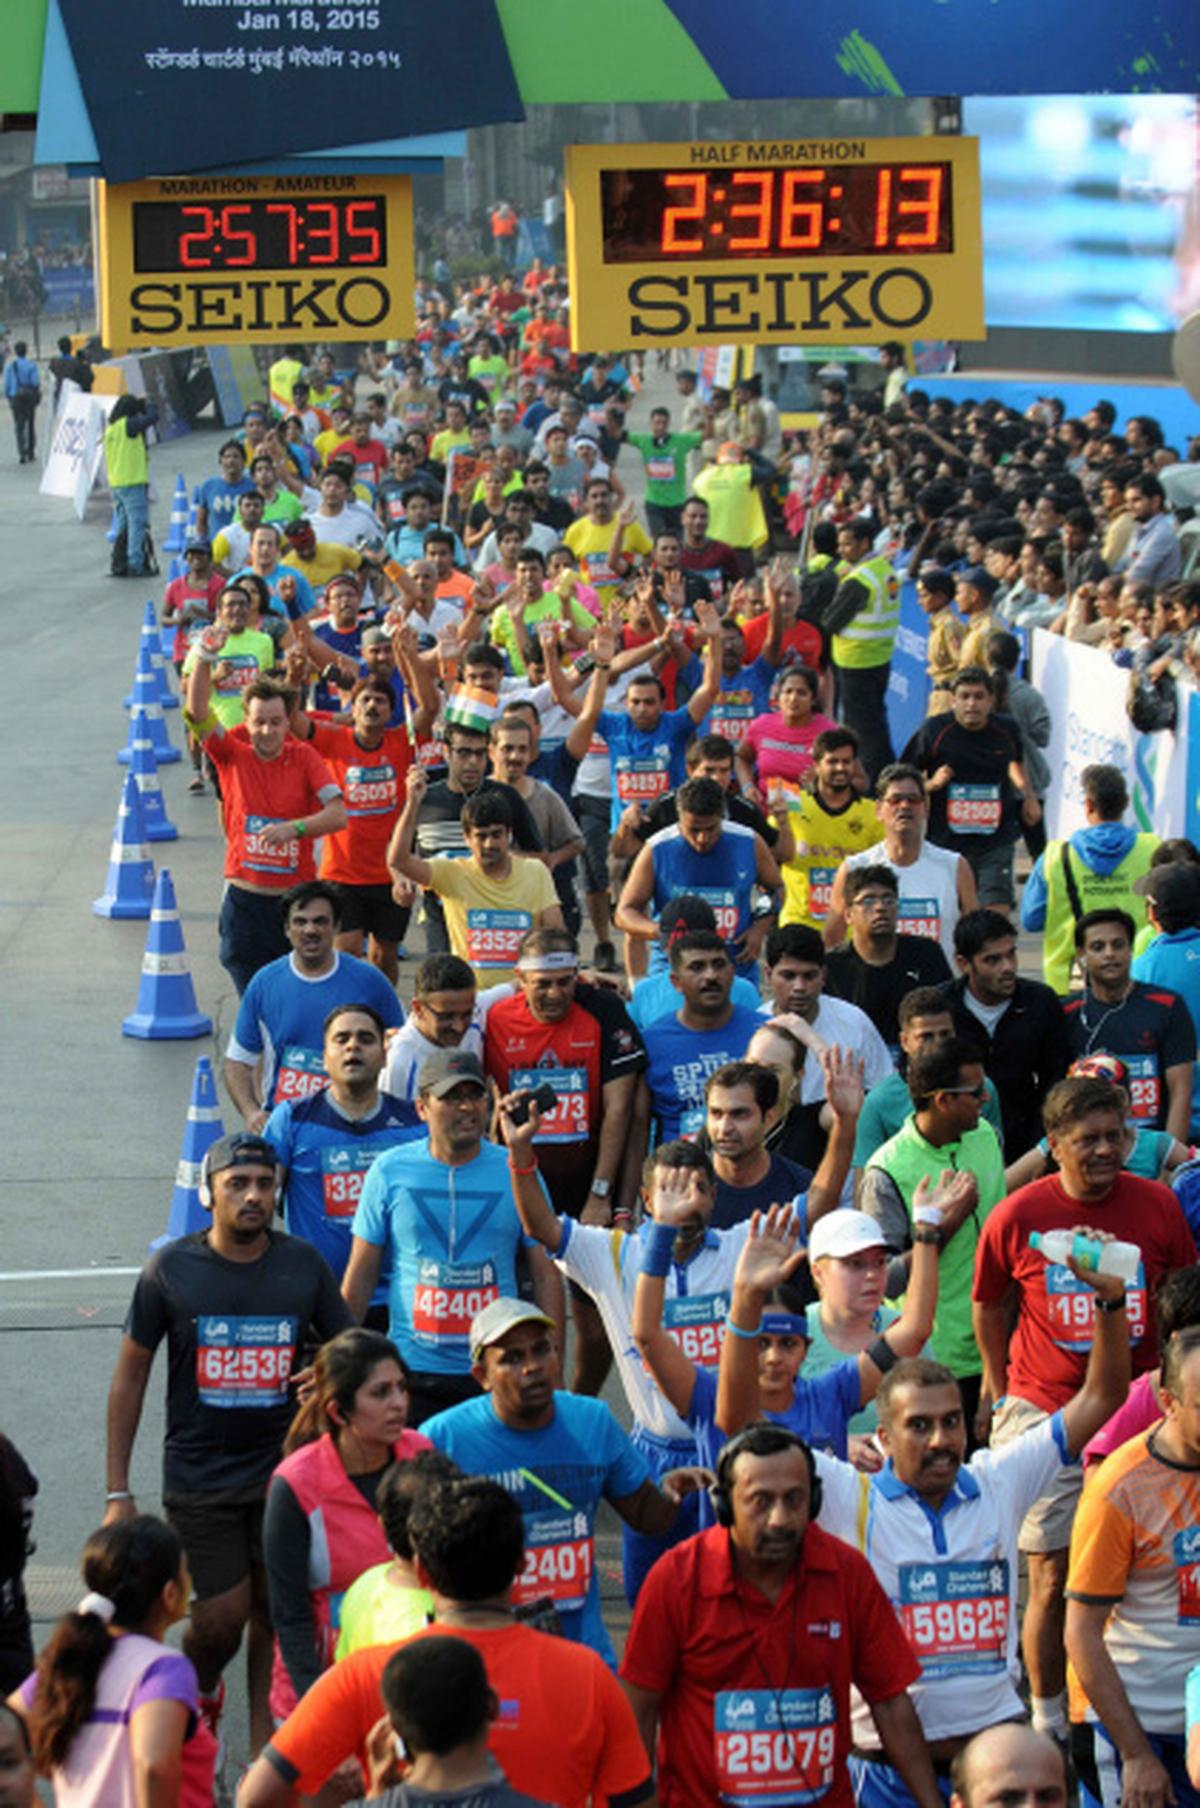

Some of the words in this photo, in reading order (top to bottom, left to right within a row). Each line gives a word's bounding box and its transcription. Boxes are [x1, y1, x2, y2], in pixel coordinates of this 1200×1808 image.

[237, 10, 280, 30] Jan
[286, 10, 320, 32] 18,
[326, 9, 380, 30] 2015
[690, 147, 741, 163] HALF
[746, 142, 866, 161] MARATHON
[160, 179, 259, 195] MARATHON
[272, 176, 357, 192] AMATEUR
[130, 276, 391, 334] SEIKO
[627, 266, 934, 337] SEIKO
[205, 1348, 292, 1380] 62536
[912, 1600, 1008, 1646] 59625
[727, 1727, 835, 1774] 25079
